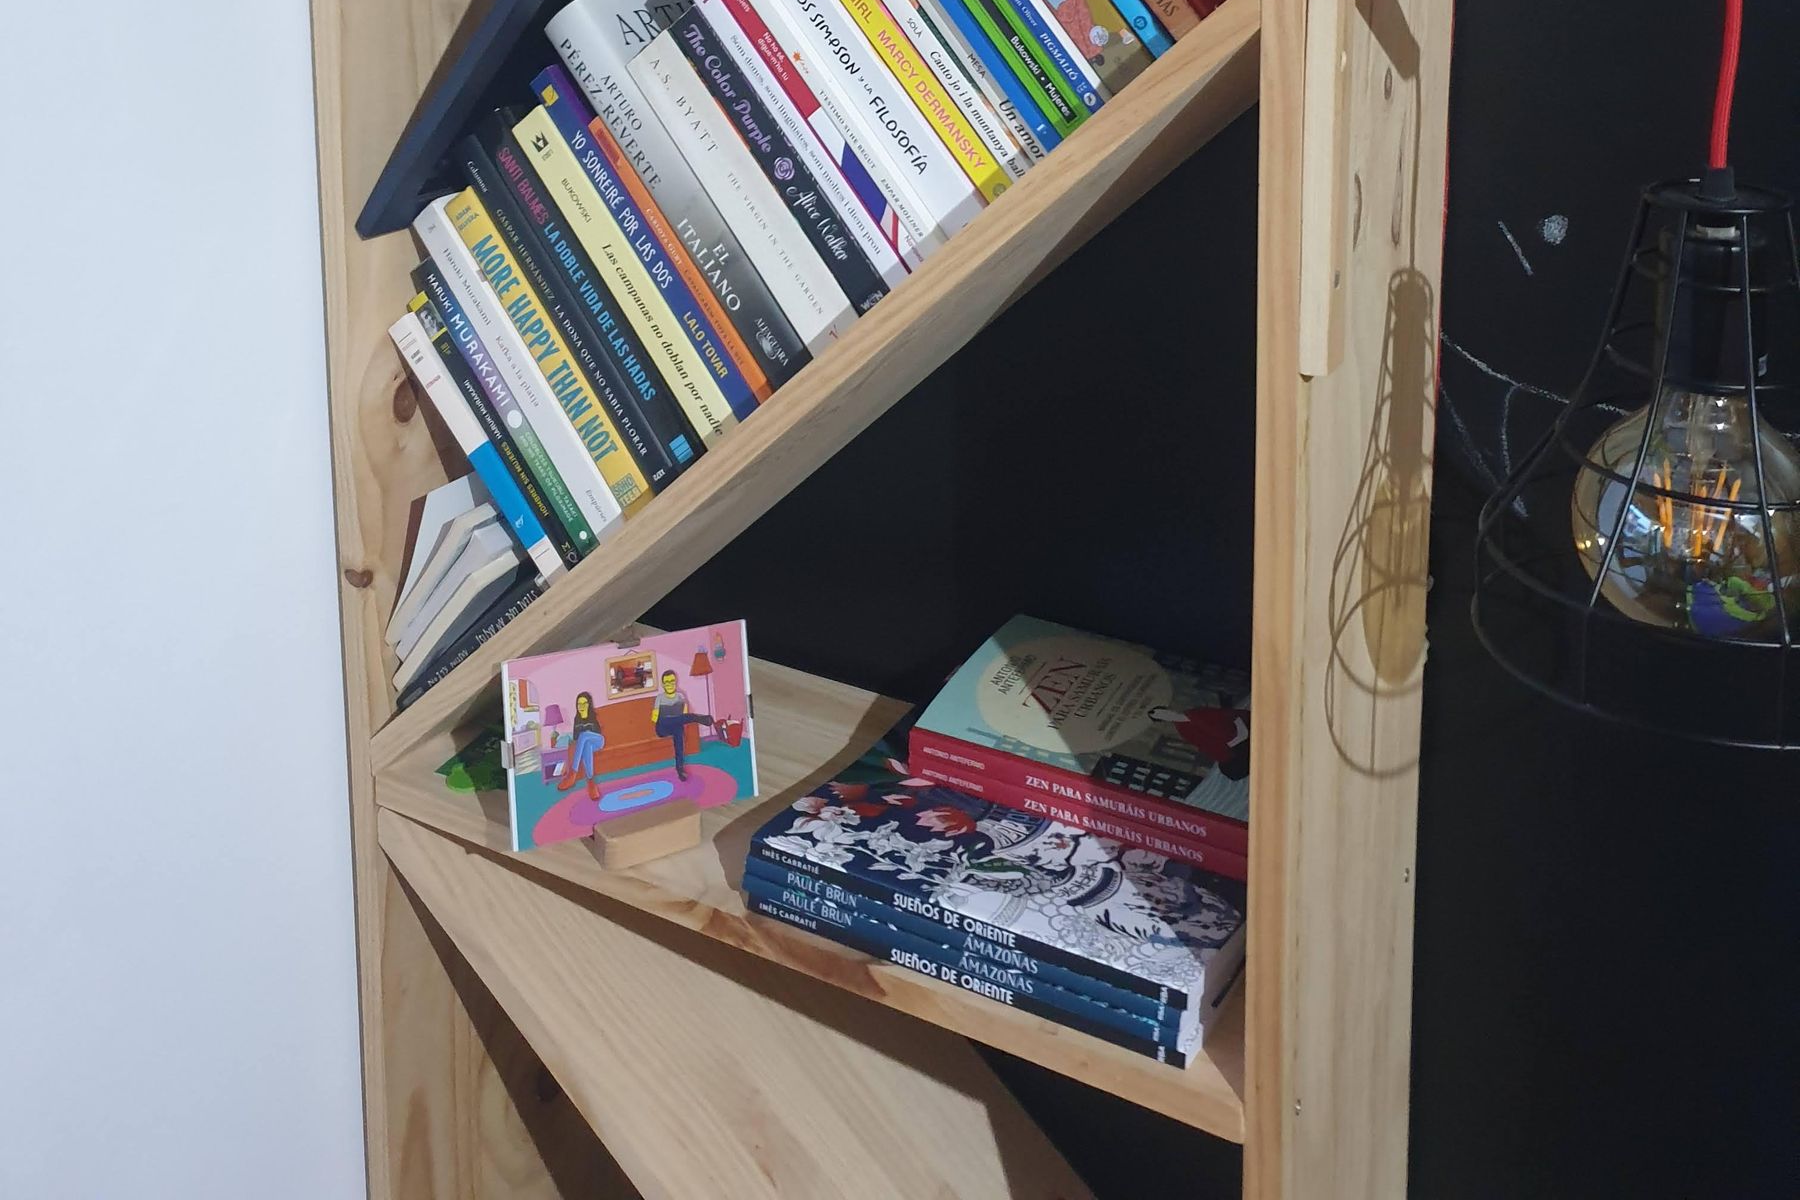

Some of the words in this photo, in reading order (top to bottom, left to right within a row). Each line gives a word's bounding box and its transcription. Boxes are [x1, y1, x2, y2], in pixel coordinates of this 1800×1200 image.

[763, 31, 774, 45] No
[907, 17, 923, 38] SOLÀ
[1021, 6, 1037, 26] Oliver
[767, 40, 780, 54] ho
[967, 53, 986, 79] MESA
[1040, 33, 1078, 80] PIGMALIÓ
[601, 75, 642, 130] ARTURO
[682, 23, 709, 57] The
[703, 54, 738, 99] Color
[731, 97, 774, 154] Purple
[810, 14, 860, 74] SIMPSON
[869, 96, 927, 174] FILOSOFÍA
[878, 29, 919, 79] MARCY
[915, 81, 986, 167] DERMANSKY
[929, 50, 954, 81] Canto
[948, 79, 962, 92] jo
[962, 96, 974, 108] la
[971, 109, 1008, 157] muntanya
[1009, 35, 1043, 76] Bukowski
[1043, 82, 1073, 118] Mujeres
[561, 39, 660, 188] PÉREZ-REVERTE
[676, 96, 718, 151] BYATT
[999, 100, 1017, 121] Un
[467, 161, 488, 192] Columna
[498, 147, 524, 181] SANTI
[857, 144, 876, 169] BEGUT
[880, 179, 900, 203] EMPAR
[561, 178, 592, 223] BUKOWSKI
[569, 129, 587, 150] YO
[583, 150, 624, 209] SONREIRÉ
[618, 207, 639, 236] POR
[635, 235, 656, 262] LAS
[652, 261, 673, 289] DOS
[785, 181, 823, 221] Alice
[496, 209, 519, 243] GASPAR
[518, 244, 555, 299] HERNÁNDEZ
[678, 219, 740, 311] ITALIANO
[711, 243, 731, 266] EL
[727, 172, 741, 190] THE
[744, 195, 766, 230] VIRGIN
[767, 233, 778, 246] IN
[795, 274, 823, 314] GARDEN
[443, 248, 463, 279] Haruki
[462, 279, 491, 326] Murakami
[544, 222, 560, 243] LA
[554, 240, 585, 283] DOBLE
[579, 280, 603, 314] VIDA
[597, 310, 615, 332] DE
[608, 328, 630, 357] LAS
[623, 354, 656, 401] HADAS
[427, 274, 453, 312] HARUKI
[450, 314, 509, 406] MURAKAMI
[472, 234, 520, 298] MORE
[507, 294, 560, 363] HAPPY
[544, 360, 592, 421] THAN
[575, 415, 618, 463] NOT
[602, 244, 618, 265] Las
[616, 267, 653, 322] campanas
[650, 324, 663, 339] no
[661, 341, 688, 379] doblan
[683, 381, 703, 403] por
[699, 403, 724, 436] nadie
[683, 311, 705, 341] LALO
[702, 340, 728, 378] TOVAR
[756, 318, 789, 366] ALFAGUARA
[464, 379, 487, 415] MURAKAMI
[495, 335, 512, 362] Kafka
[520, 381, 539, 407] platja
[554, 305, 565, 319] LA
[563, 319, 582, 347] DONA
[581, 348, 596, 369] QUE
[594, 370, 606, 386] NO
[605, 387, 623, 416] SABIA
[622, 417, 647, 456] PLORAR
[484, 413, 502, 439] HARUKI
[501, 441, 522, 472] MUJERES
[551, 487, 573, 522] PILGRIMAGE
[585, 489, 607, 522] Empúries
[1024, 798, 1047, 813] ZEN
[1050, 806, 1079, 824] PARA
[1080, 816, 1142, 843] SAMURÁIS
[1146, 836, 1203, 862] URBANOS
[1026, 775, 1049, 790] ZEN
[1053, 783, 1082, 800] PARA
[1085, 793, 1145, 818] SAMURÁIS
[1149, 811, 1207, 837] URBANOS
[782, 891, 816, 913] PAULE
[820, 905, 852, 926] BRUN
[824, 886, 857, 907] BRUN
[893, 893, 945, 920] SUEÑOS
[963, 917, 1018, 948] ORIENTE
[888, 948, 939, 978] SUEÑOS
[957, 975, 1013, 1006] ORIENTE
